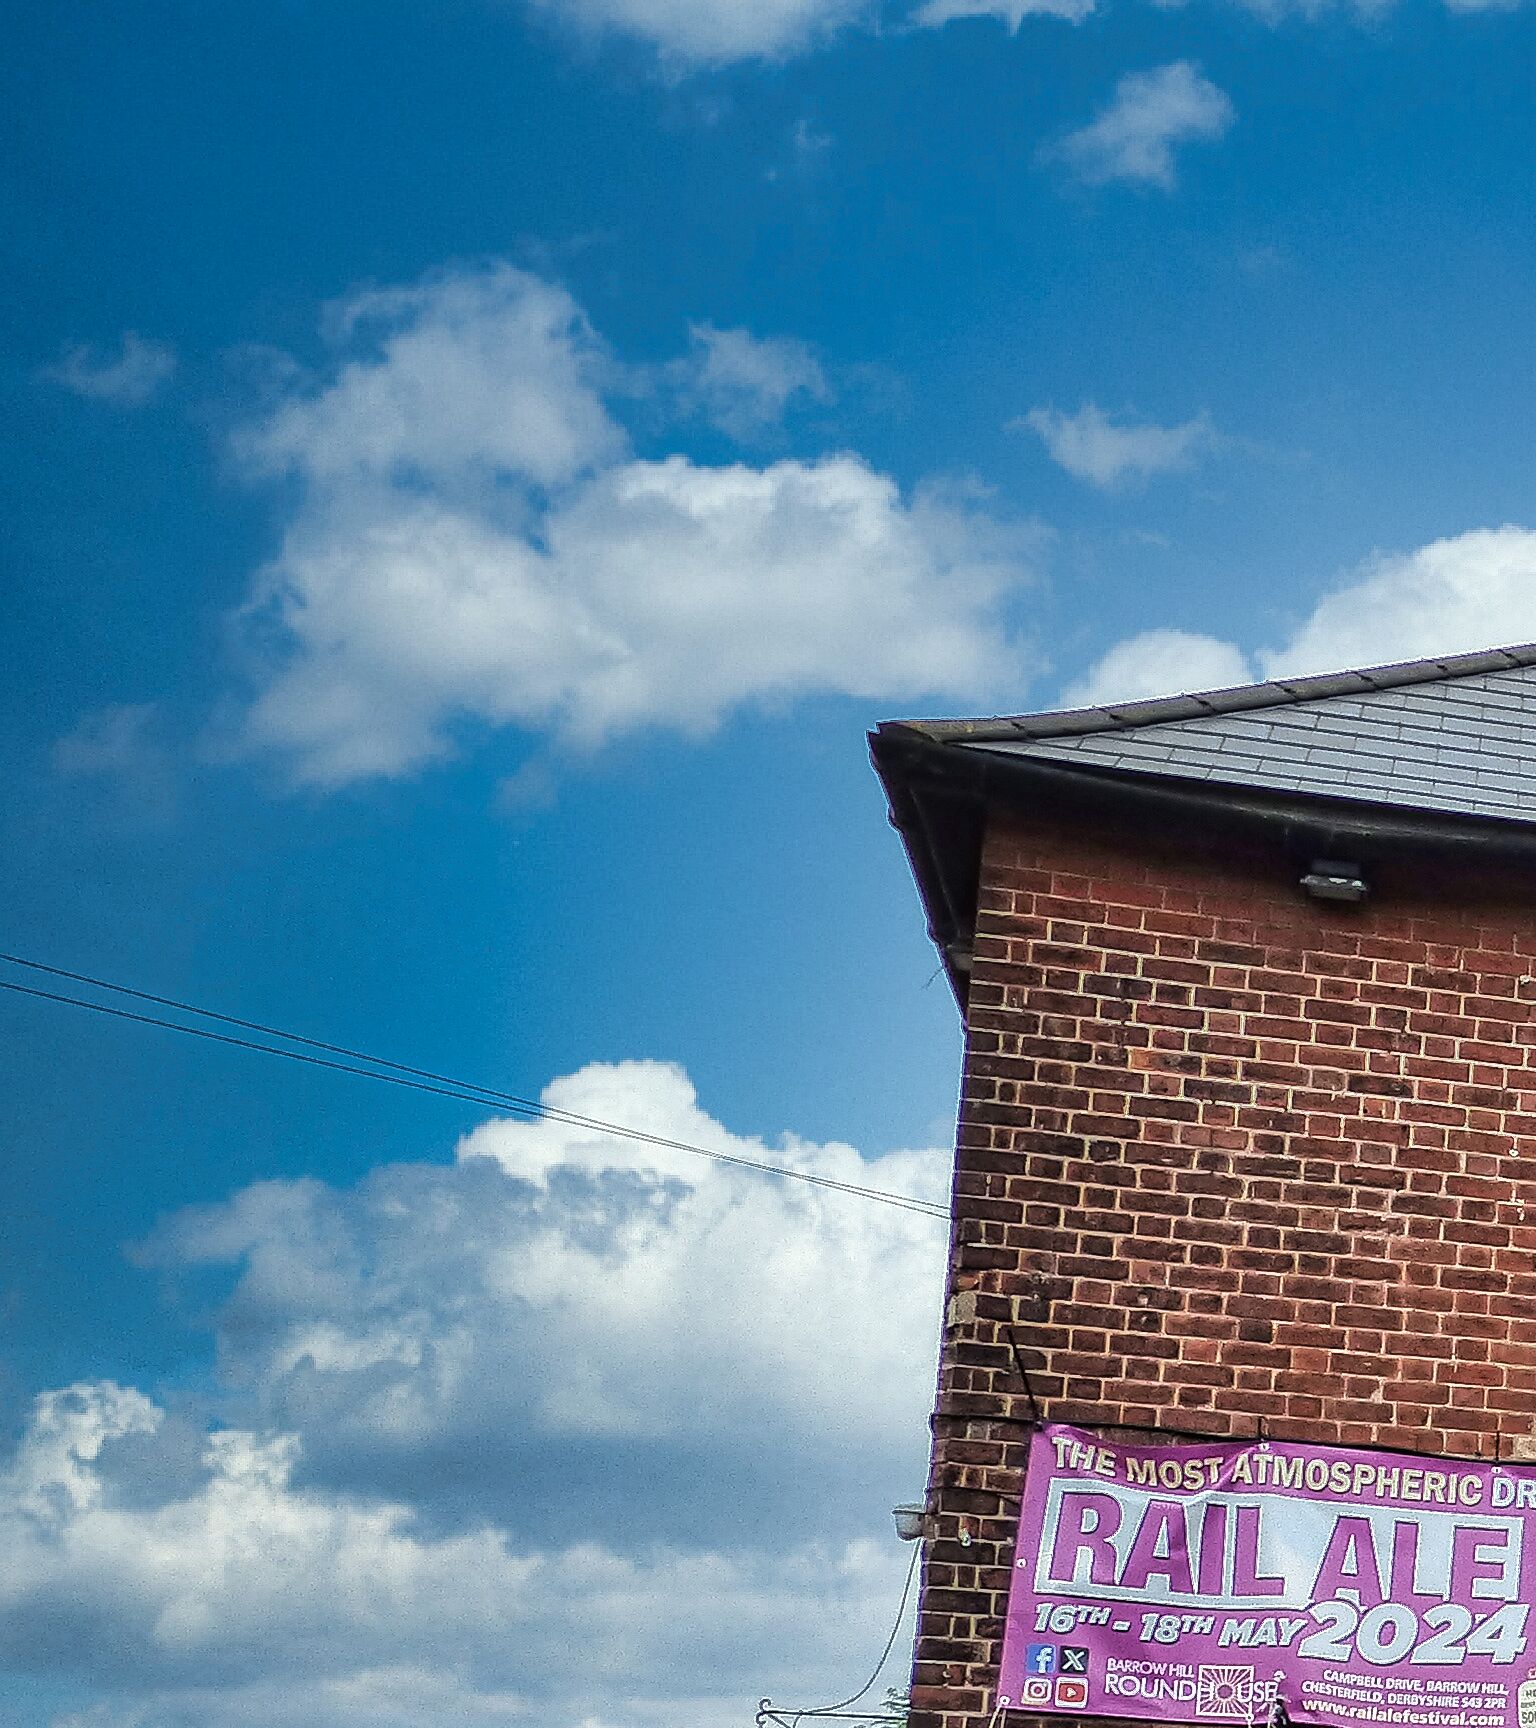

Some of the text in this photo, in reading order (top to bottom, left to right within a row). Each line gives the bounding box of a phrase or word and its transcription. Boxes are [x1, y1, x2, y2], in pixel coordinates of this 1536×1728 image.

[1052, 1436, 1117, 1477] THE
[1125, 1456, 1223, 1490] MOST
[1231, 1453, 1483, 1506] ATMOSPHERIC
[1048, 1491, 1510, 1605] RAIL ALE
[1033, 1603, 1111, 1633] 16TH
[1139, 1613, 1215, 1643] 18TH
[1217, 1617, 1308, 1647] MAY
[1297, 1599, 1530, 1666] 2024
[1106, 1658, 1195, 1679] BARROW HILL
[1323, 1669, 1383, 1690] CAMPBELL
[1426, 1680, 1480, 1694] BARROW
[1301, 1680, 1386, 1706] CHESTERFIELD,
[1387, 1692, 1459, 1709] DERBYSHIRE
[1461, 1695, 1482, 1709] S43
[1484, 1696, 1507, 1710] 2PR
[1302, 1699, 1505, 1727] www.railalefestival.com
